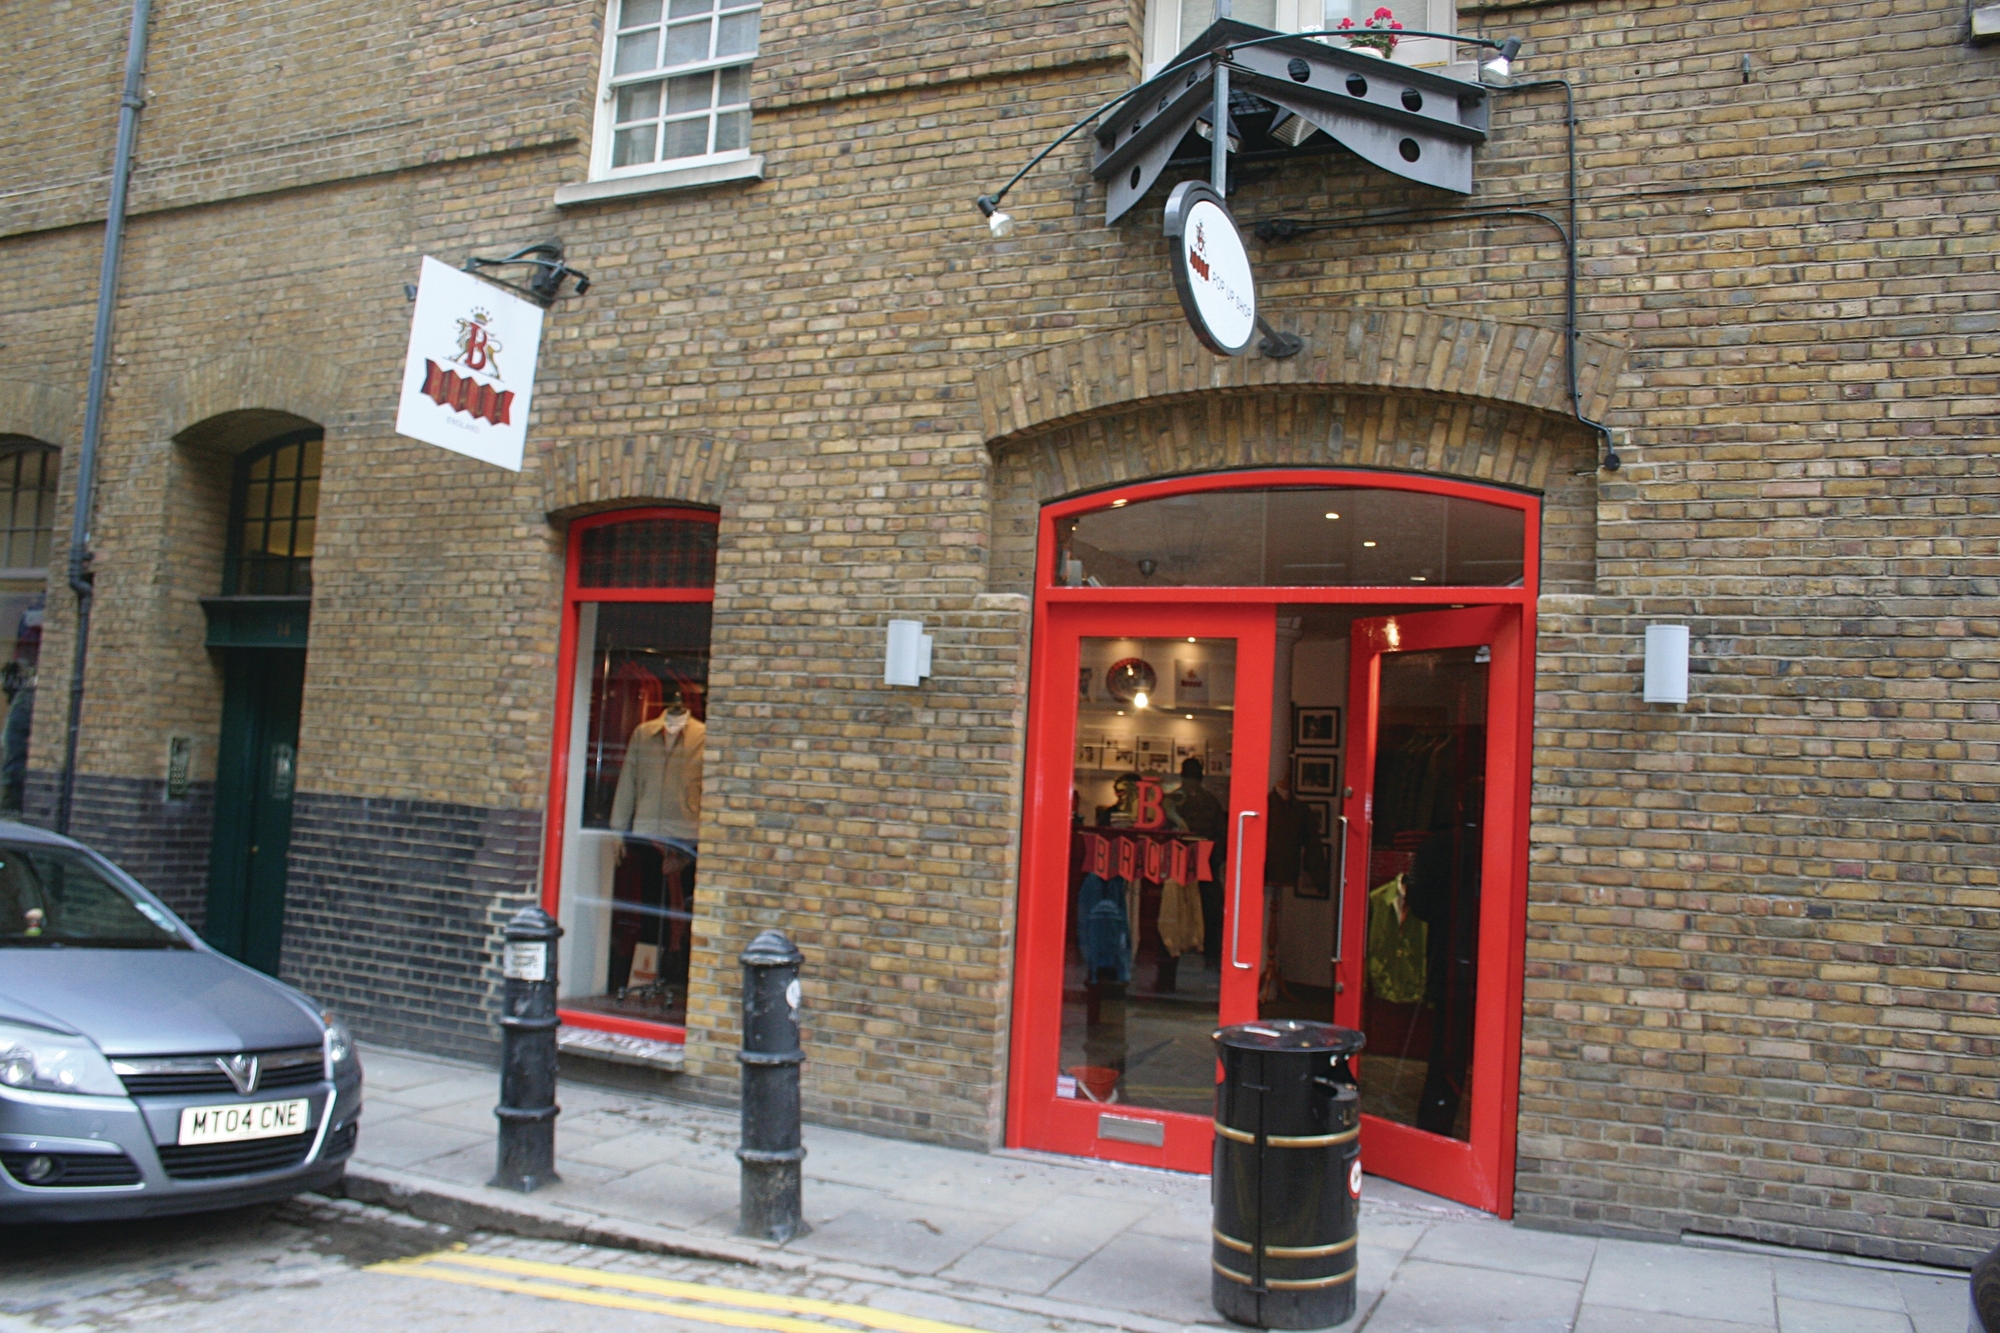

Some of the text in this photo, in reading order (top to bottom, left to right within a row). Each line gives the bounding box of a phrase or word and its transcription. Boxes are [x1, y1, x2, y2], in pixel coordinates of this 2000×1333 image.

[1212, 271, 1252, 320] POP UP SHOP
[464, 321, 488, 370] B
[446, 416, 480, 434] ENGLAND
[1134, 781, 1166, 830] B
[193, 1103, 298, 1135] MT04 CNE
